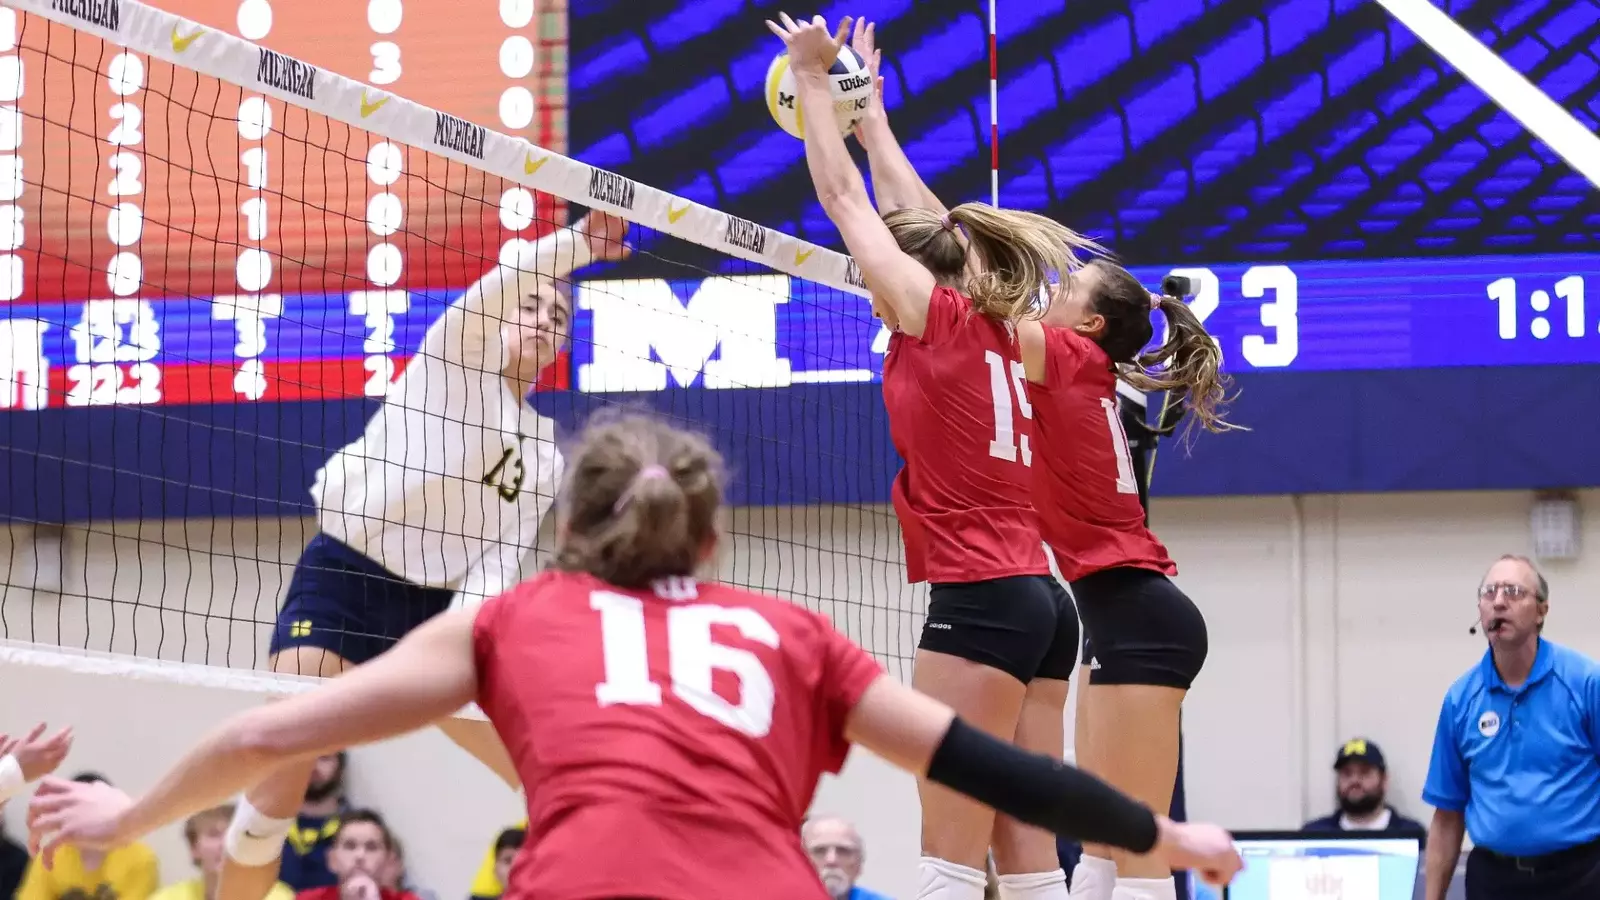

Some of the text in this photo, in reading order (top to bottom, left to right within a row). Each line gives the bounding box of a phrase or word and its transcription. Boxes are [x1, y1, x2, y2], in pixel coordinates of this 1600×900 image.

[257, 48, 317, 100] MICHIGAN
[368, 42, 402, 85] 3
[837, 75, 871, 92] Wilson
[778, 92, 795, 109] M
[108, 103, 143, 145] 2
[434, 112, 486, 160] MICHIGAN
[108, 153, 143, 195] 2
[241, 148, 268, 190] 1
[588, 167, 635, 210] MICHIGAN
[241, 198, 268, 241] 1
[724, 214, 766, 254] MICHIGAN
[1486, 275, 1600, 340] 1:1
[578, 273, 791, 392] M
[482, 448, 525, 502] 13
[589, 589, 781, 738] 16
